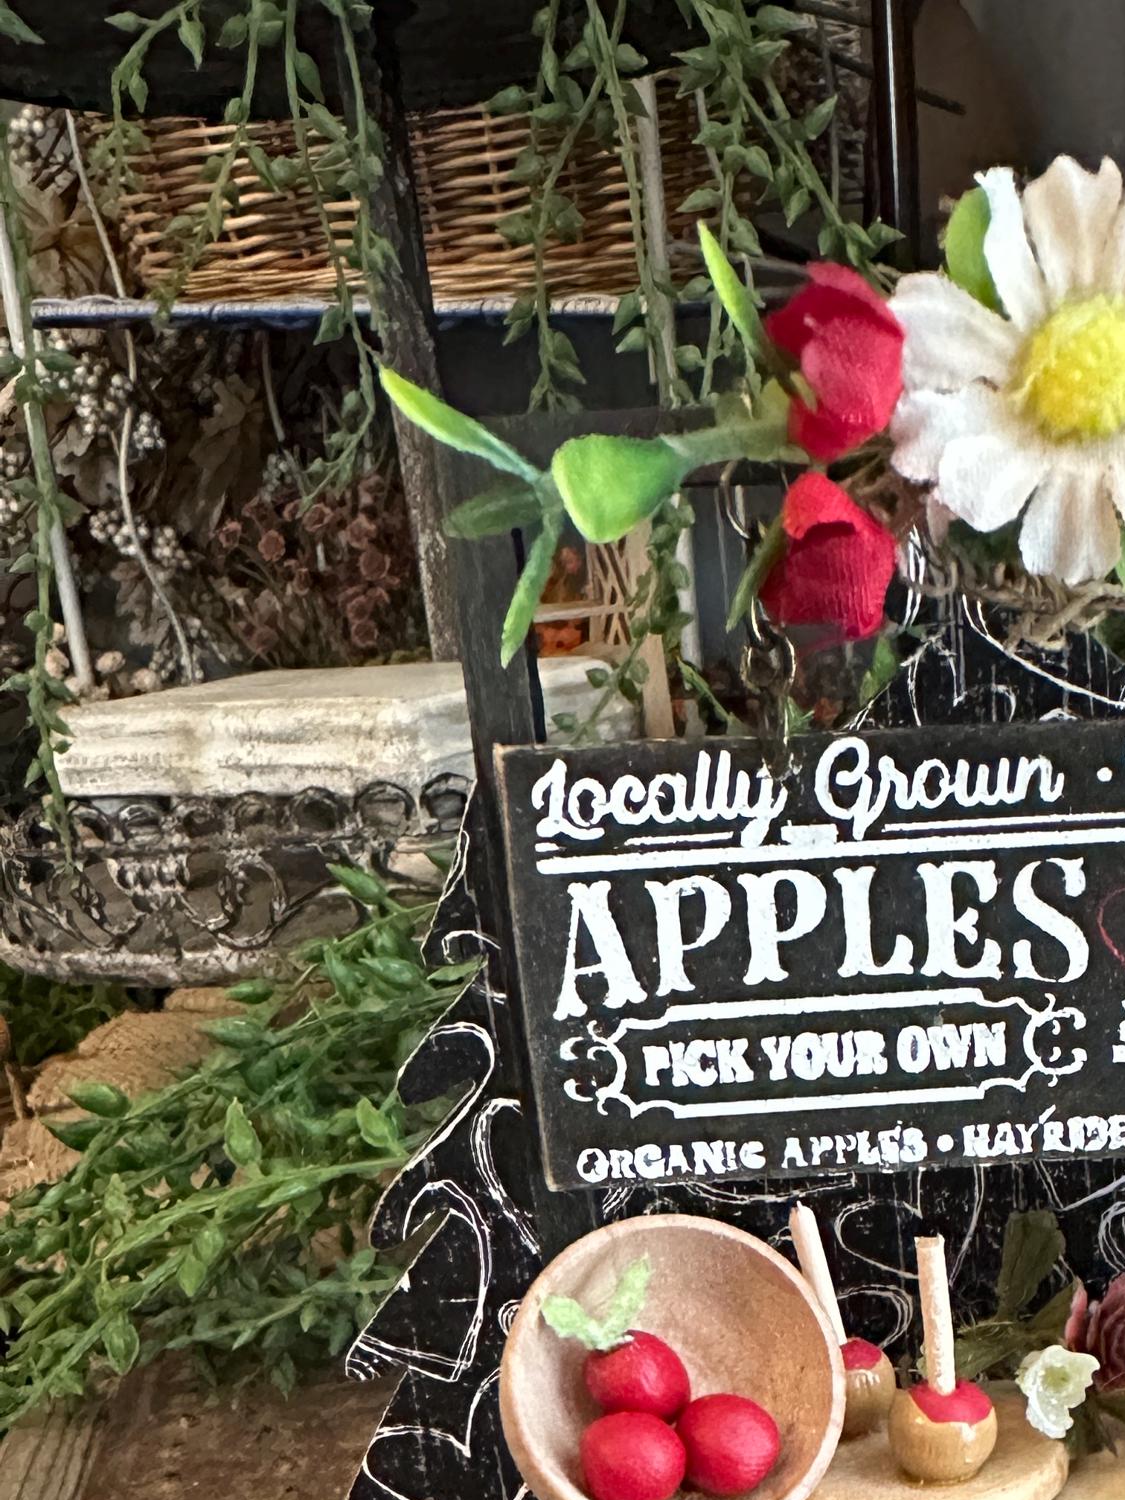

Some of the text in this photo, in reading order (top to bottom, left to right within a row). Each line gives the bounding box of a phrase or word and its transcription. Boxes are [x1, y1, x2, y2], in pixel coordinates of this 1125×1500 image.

[531, 750, 788, 848] Locally
[814, 736, 1065, 841] Grown
[553, 857, 1090, 1021] APPLES
[643, 1021, 1007, 1087] PICK YOUR OWN
[576, 1140, 767, 1184] ORGANIC
[781, 1125, 928, 1170] APPLES
